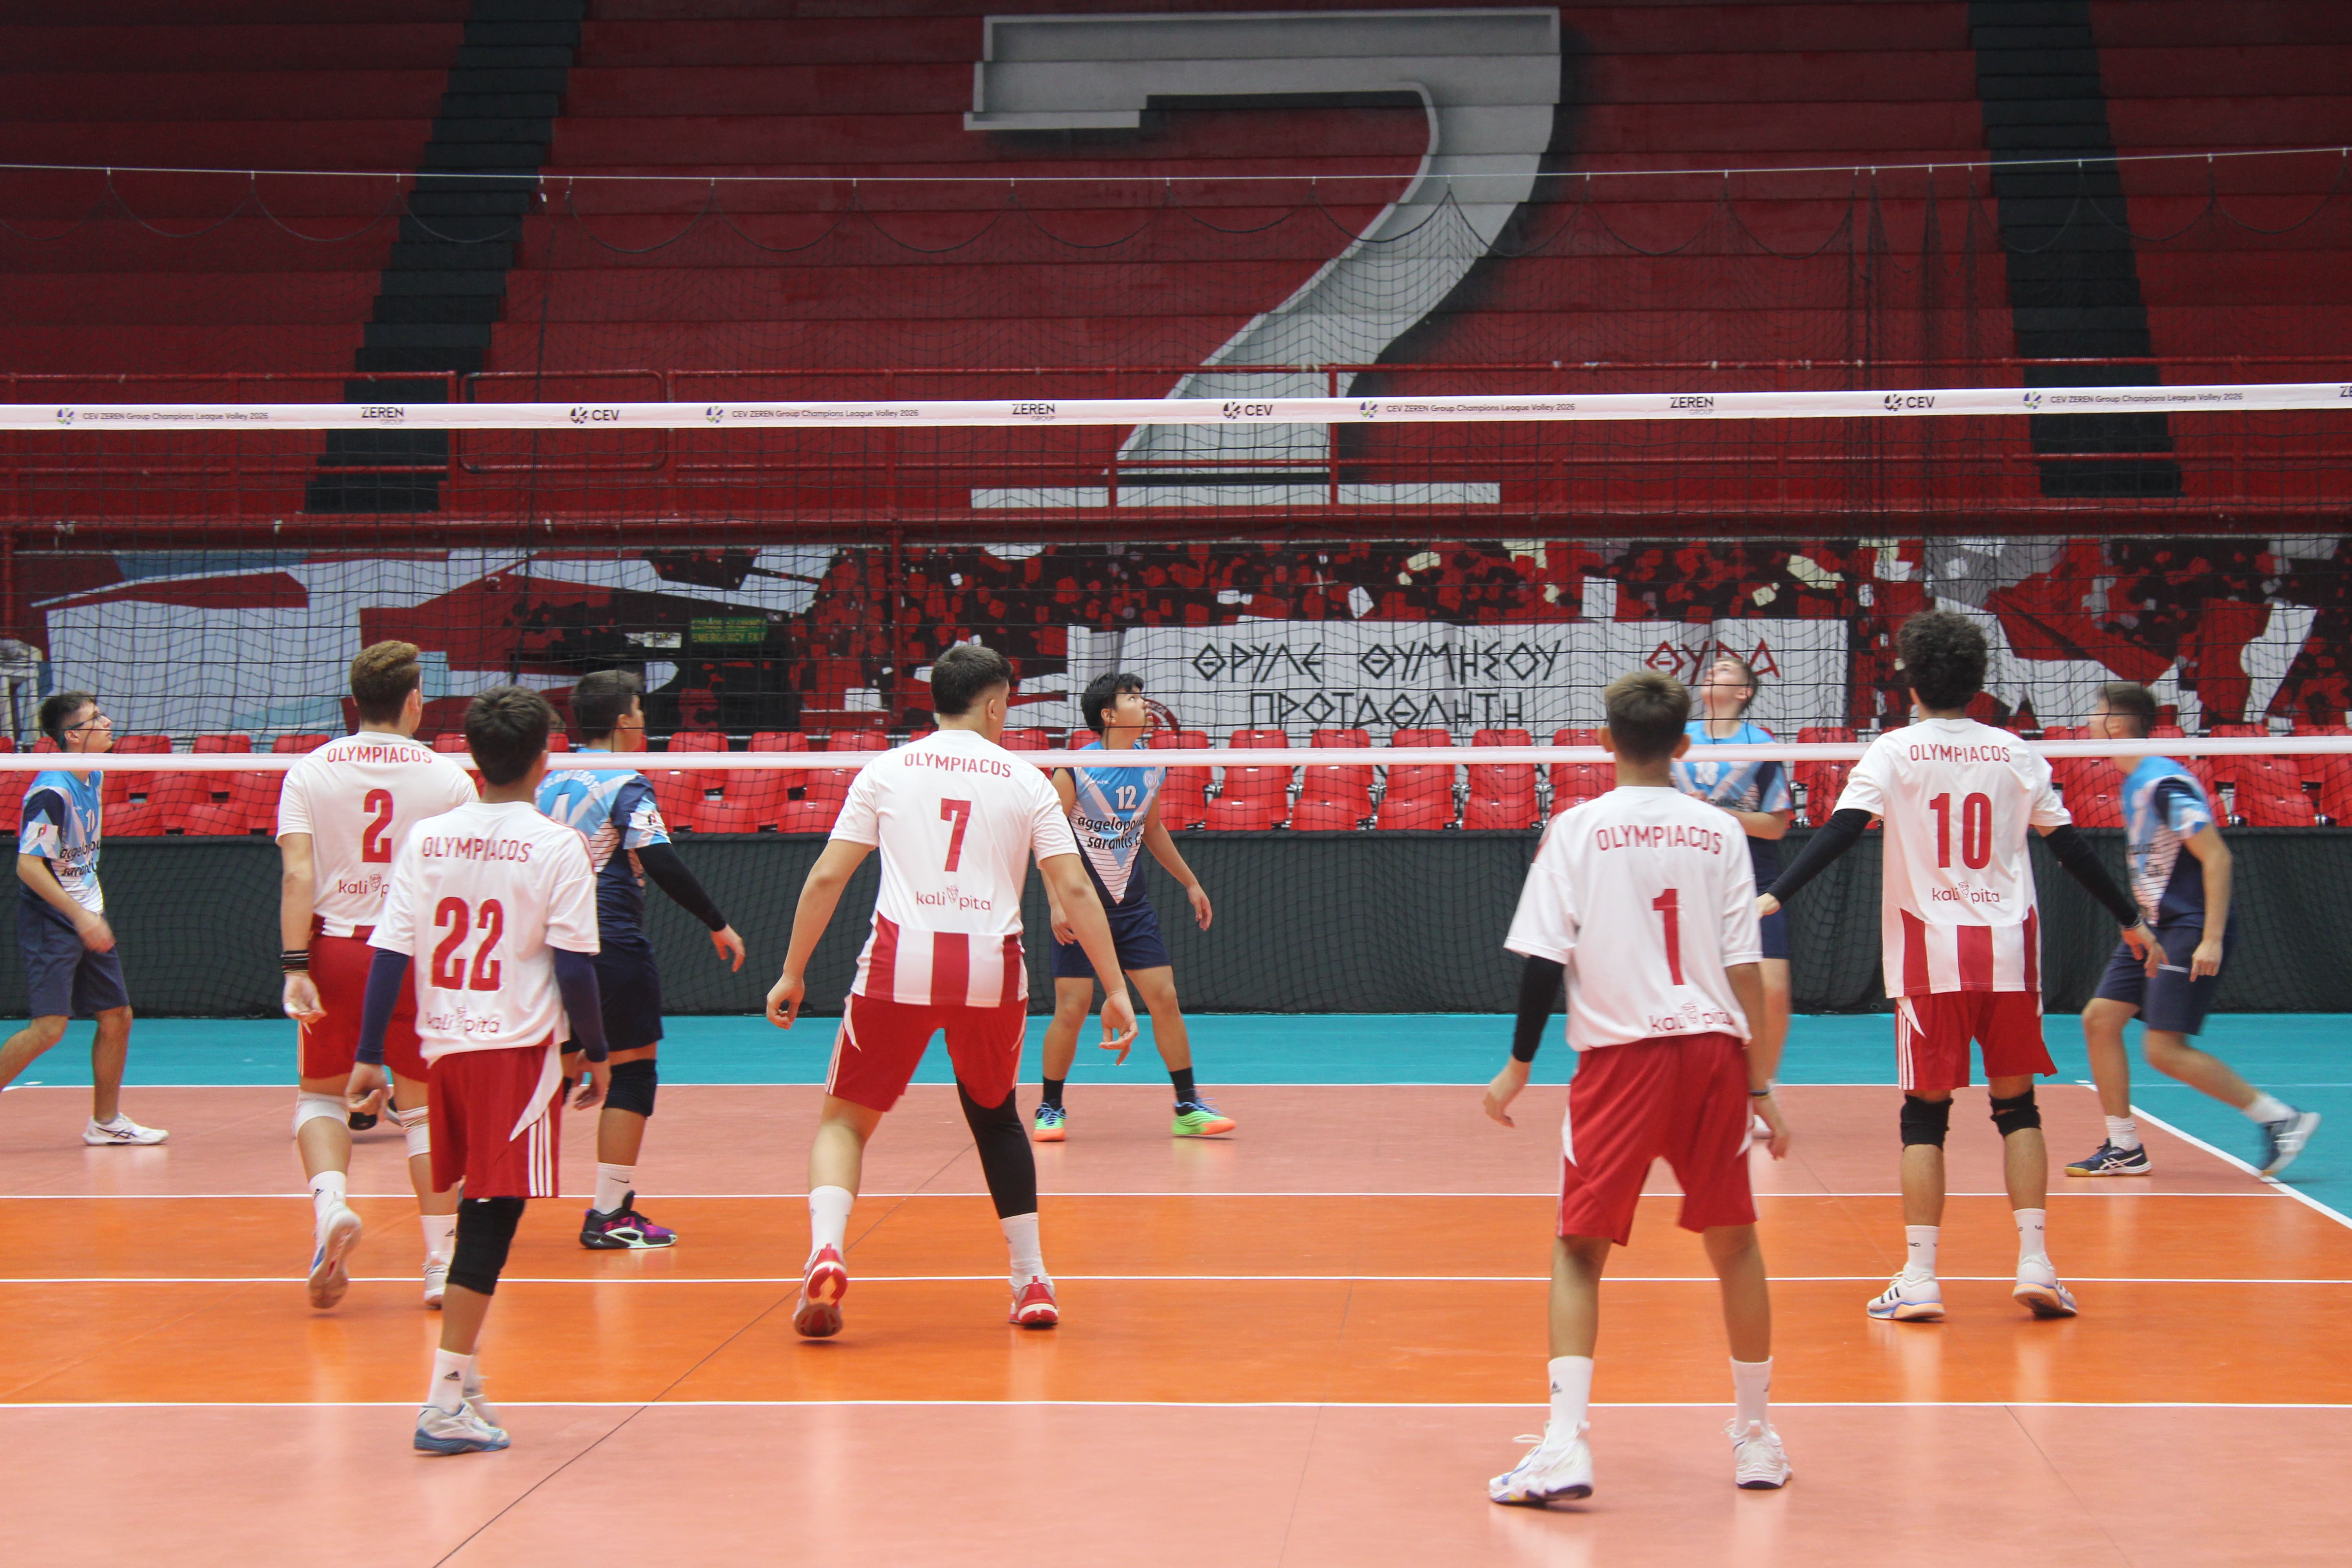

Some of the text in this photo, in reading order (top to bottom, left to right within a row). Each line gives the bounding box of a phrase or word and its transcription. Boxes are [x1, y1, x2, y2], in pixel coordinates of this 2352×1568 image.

[1670, 396, 1714, 408] ZEREN
[1907, 396, 1935, 408] CEV
[2198, 393, 2221, 401] Volley
[225, 412, 248, 421] Volley
[361, 407, 404, 418] ZEREN
[592, 409, 620, 421] CEV
[1012, 403, 1055, 414] ZEREN
[1245, 405, 1273, 416] CEV
[1457, 404, 1499, 412] Champions
[1531, 403, 1555, 412] Volley
[1192, 639, 1562, 685] ΘΡΥΛΕ ΘΥΜΗΣΟΥ
[327, 746, 432, 764] OLYMPIACOS
[1910, 744, 2010, 763] OLYMPIACOS
[904, 752, 1012, 778] OLYMPIACOS
[1115, 785, 1136, 809] 12
[362, 789, 394, 862] 2
[1930, 792, 1992, 869] 10
[941, 798, 971, 872] 7
[1087, 833, 1132, 850] sarantis
[1597, 824, 1723, 855] OLYMPIACOS
[423, 837, 533, 862] OLYMPIACOS
[338, 879, 367, 894] kali
[1933, 887, 2000, 904] kali pita
[916, 891, 991, 911] kali pita
[432, 897, 503, 991] 22
[1653, 888, 1685, 985] 1
[464, 1016, 500, 1035] pita
